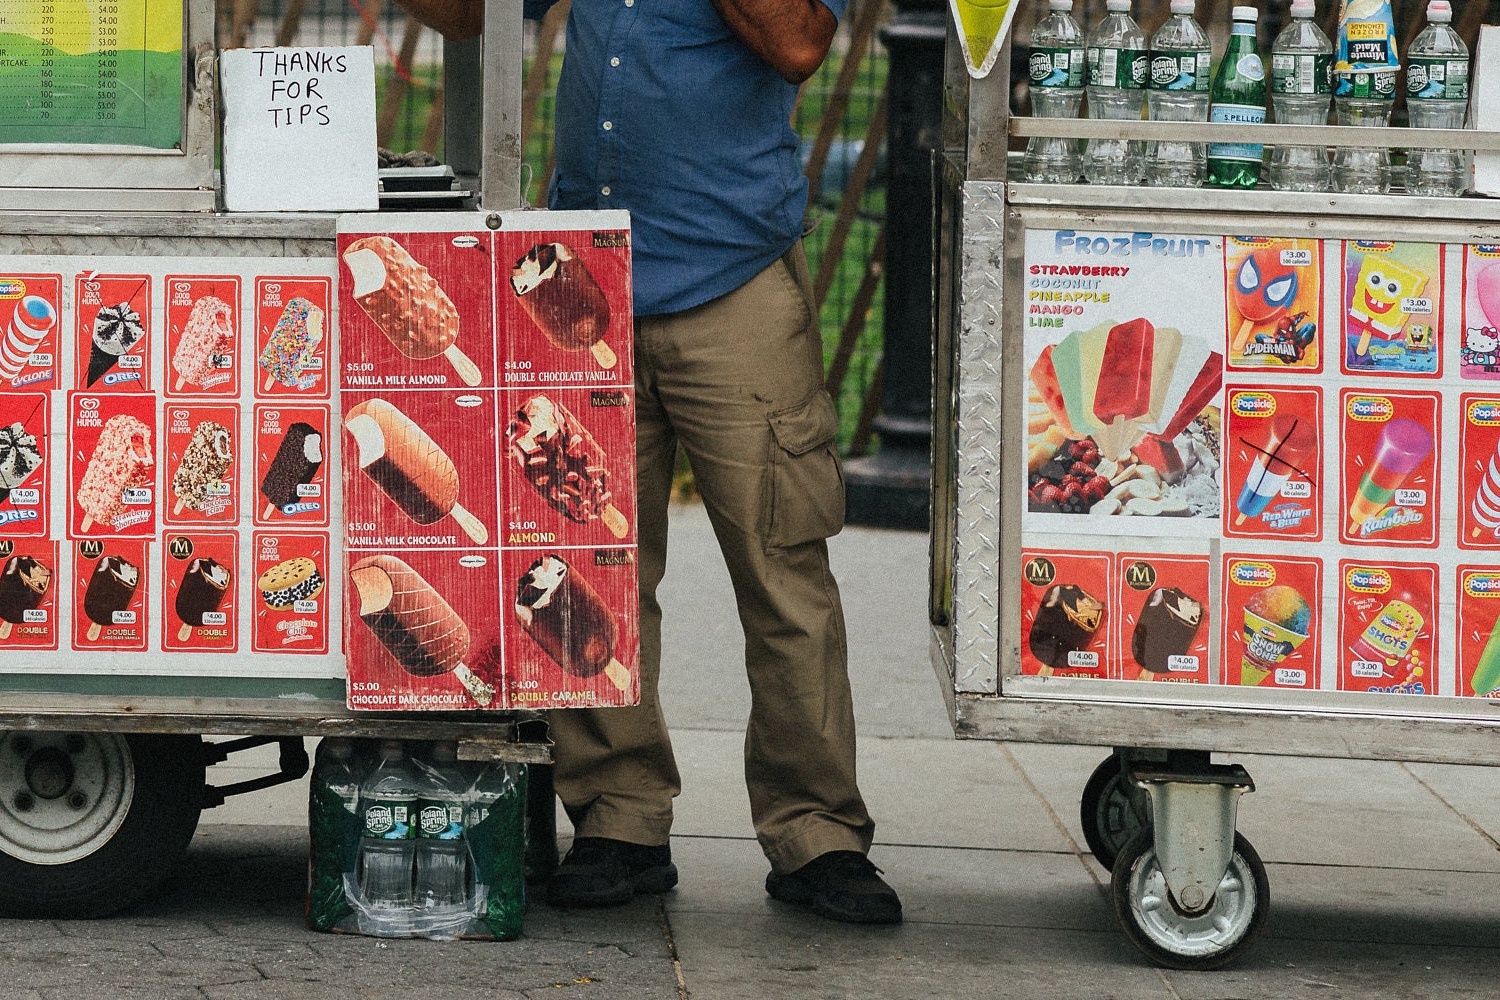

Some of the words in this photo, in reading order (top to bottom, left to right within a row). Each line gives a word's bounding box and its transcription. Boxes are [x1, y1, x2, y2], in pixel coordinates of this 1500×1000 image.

[1351, 51, 1385, 61] Minute
[252, 51, 347, 77] THANKS
[1152, 57, 1177, 70] Poland
[1152, 66, 1179, 80] Spring
[271, 77, 323, 101] FOR
[268, 104, 330, 128] TIPS
[1286, 251, 1306, 259] $3.00
[1029, 264, 1130, 277] STRAWBERRY
[1029, 278, 1102, 290] COCONUT
[1028, 291, 1110, 303] PINEAPPLE
[1028, 304, 1084, 316] MANGO
[1028, 316, 1064, 328] LIME
[346, 362, 375, 373] $5.00
[504, 360, 532, 370] $4.00
[11, 369, 54, 387] CYCLONE
[346, 375, 383, 385] VANILLA
[385, 375, 407, 385] MILK
[408, 374, 447, 385] ALMOND
[504, 372, 536, 383] DOUBLE
[538, 371, 583, 383] CHOCOLATE
[584, 370, 617, 382] VANILLA
[1237, 399, 1273, 409] Popsicle
[1286, 483, 1305, 491] $3.00
[283, 500, 320, 514] OREO
[111, 509, 152, 526] Strawberry
[114, 516, 150, 533] Shortcake
[348, 536, 383, 545] VANILLA
[385, 536, 406, 545] MILK
[407, 535, 457, 545] CHOCOLATE
[508, 532, 556, 543] ALMOND
[1074, 652, 1093, 661] $4.00
[352, 695, 397, 705] CHOCOLATE
[398, 695, 419, 704] DARK
[420, 694, 467, 704] CHOCOLATE
[511, 691, 549, 702] DOUBLE
[551, 690, 597, 701] CARAMEL
[366, 809, 391, 819] Poland
[366, 816, 392, 829] Spring
